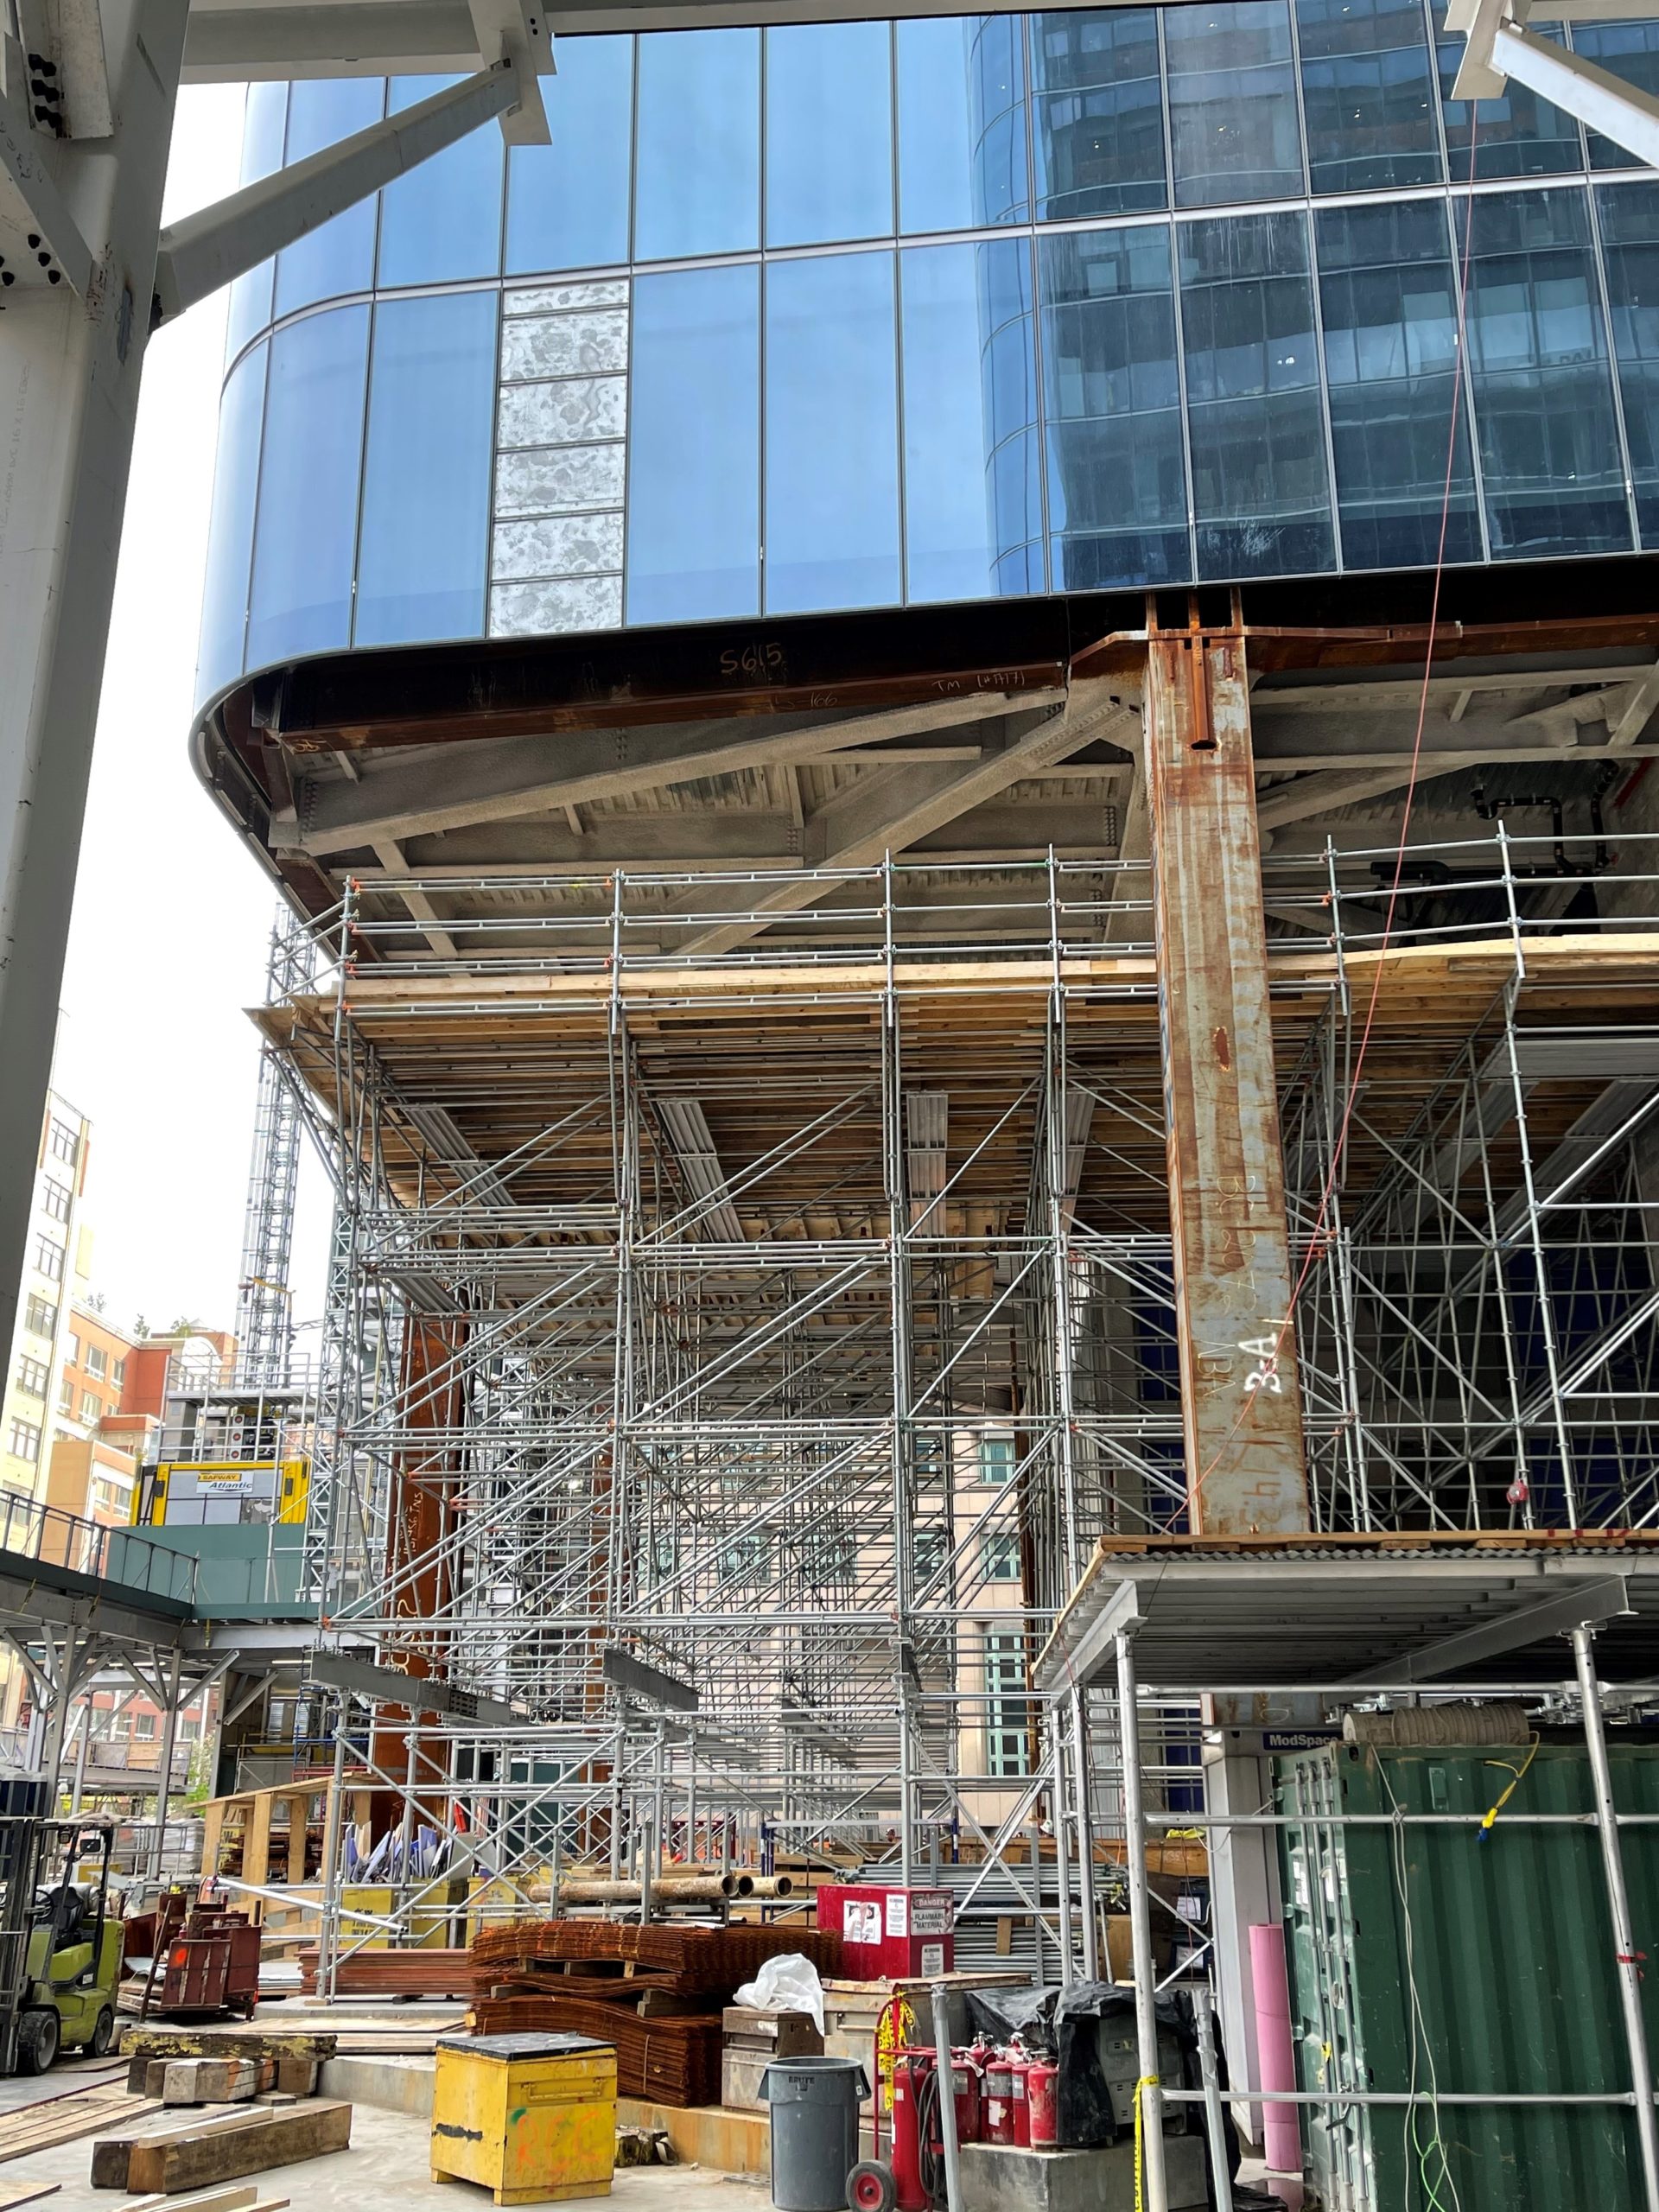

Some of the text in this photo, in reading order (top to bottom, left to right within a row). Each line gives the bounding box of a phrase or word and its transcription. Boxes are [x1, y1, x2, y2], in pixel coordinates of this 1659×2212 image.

[720, 642, 783, 674] S615
[918, 1898, 945, 1907] DANGER
[916, 1921, 944, 1929] MATERIAL
